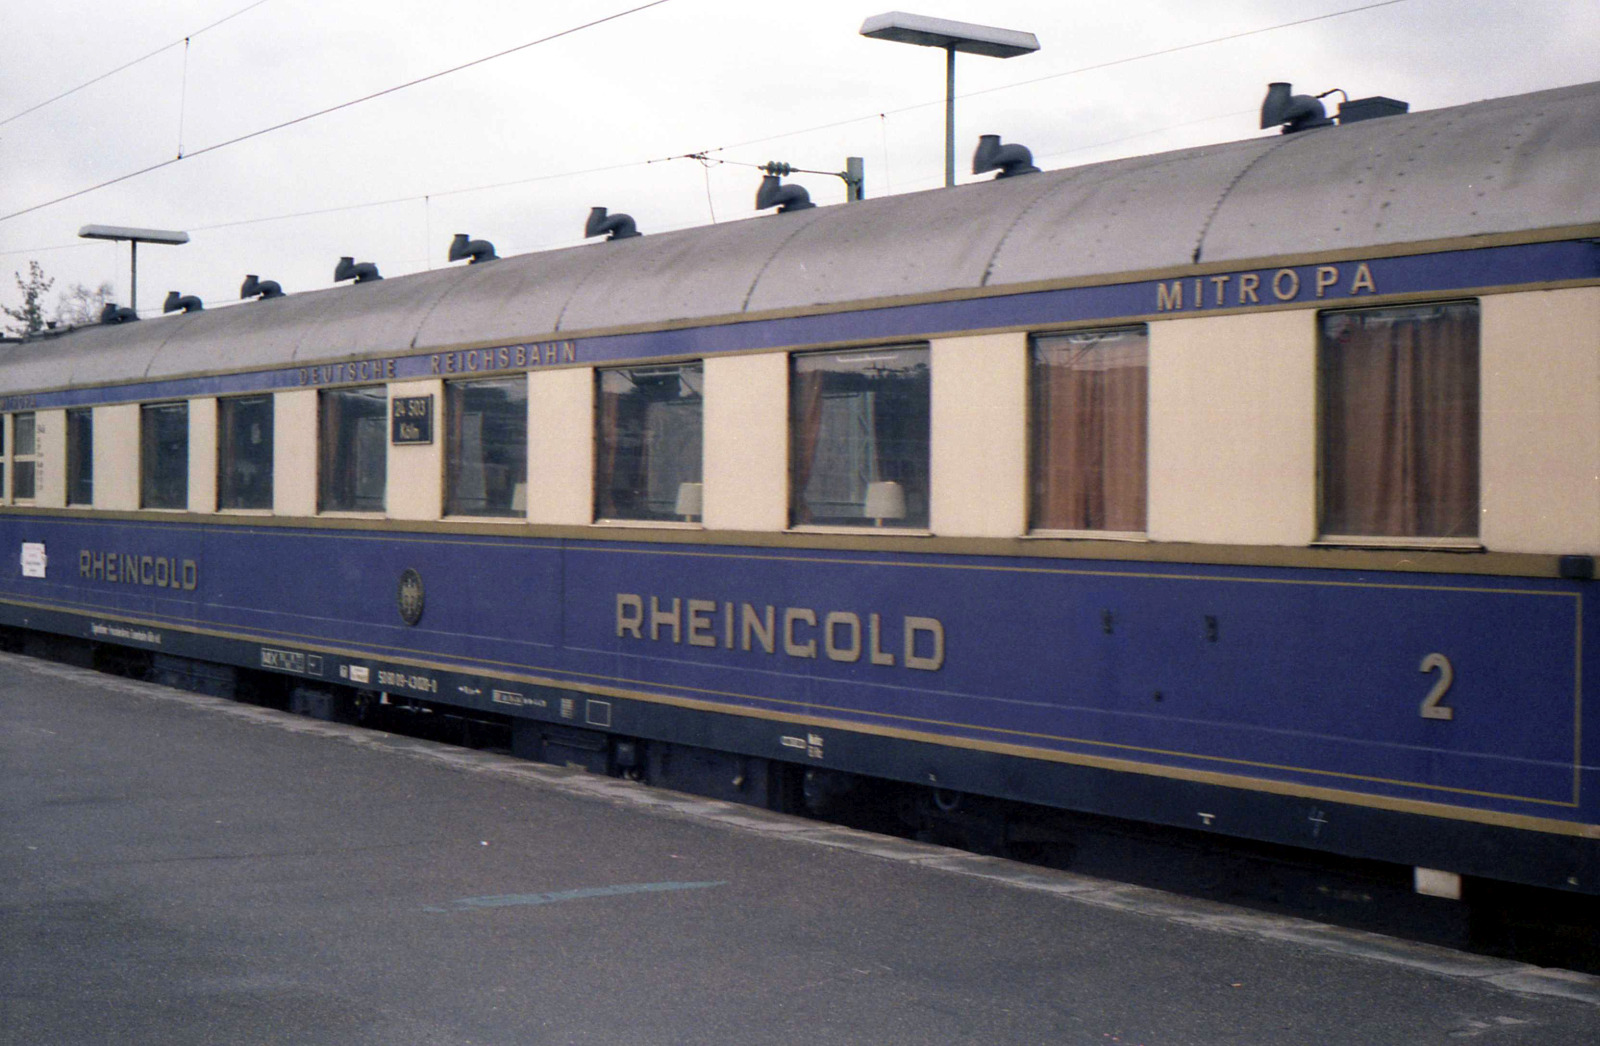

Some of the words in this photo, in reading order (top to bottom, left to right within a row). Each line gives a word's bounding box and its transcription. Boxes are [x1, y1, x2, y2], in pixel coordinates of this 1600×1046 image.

[1157, 263, 1376, 311] MITROPA
[300, 359, 396, 385] DEUTSCHE
[431, 342, 576, 375] REICHSBAHN
[80, 549, 198, 591] RHEINGOLD
[616, 593, 944, 671] RHEINGOLD
[1420, 653, 1453, 720] 2
